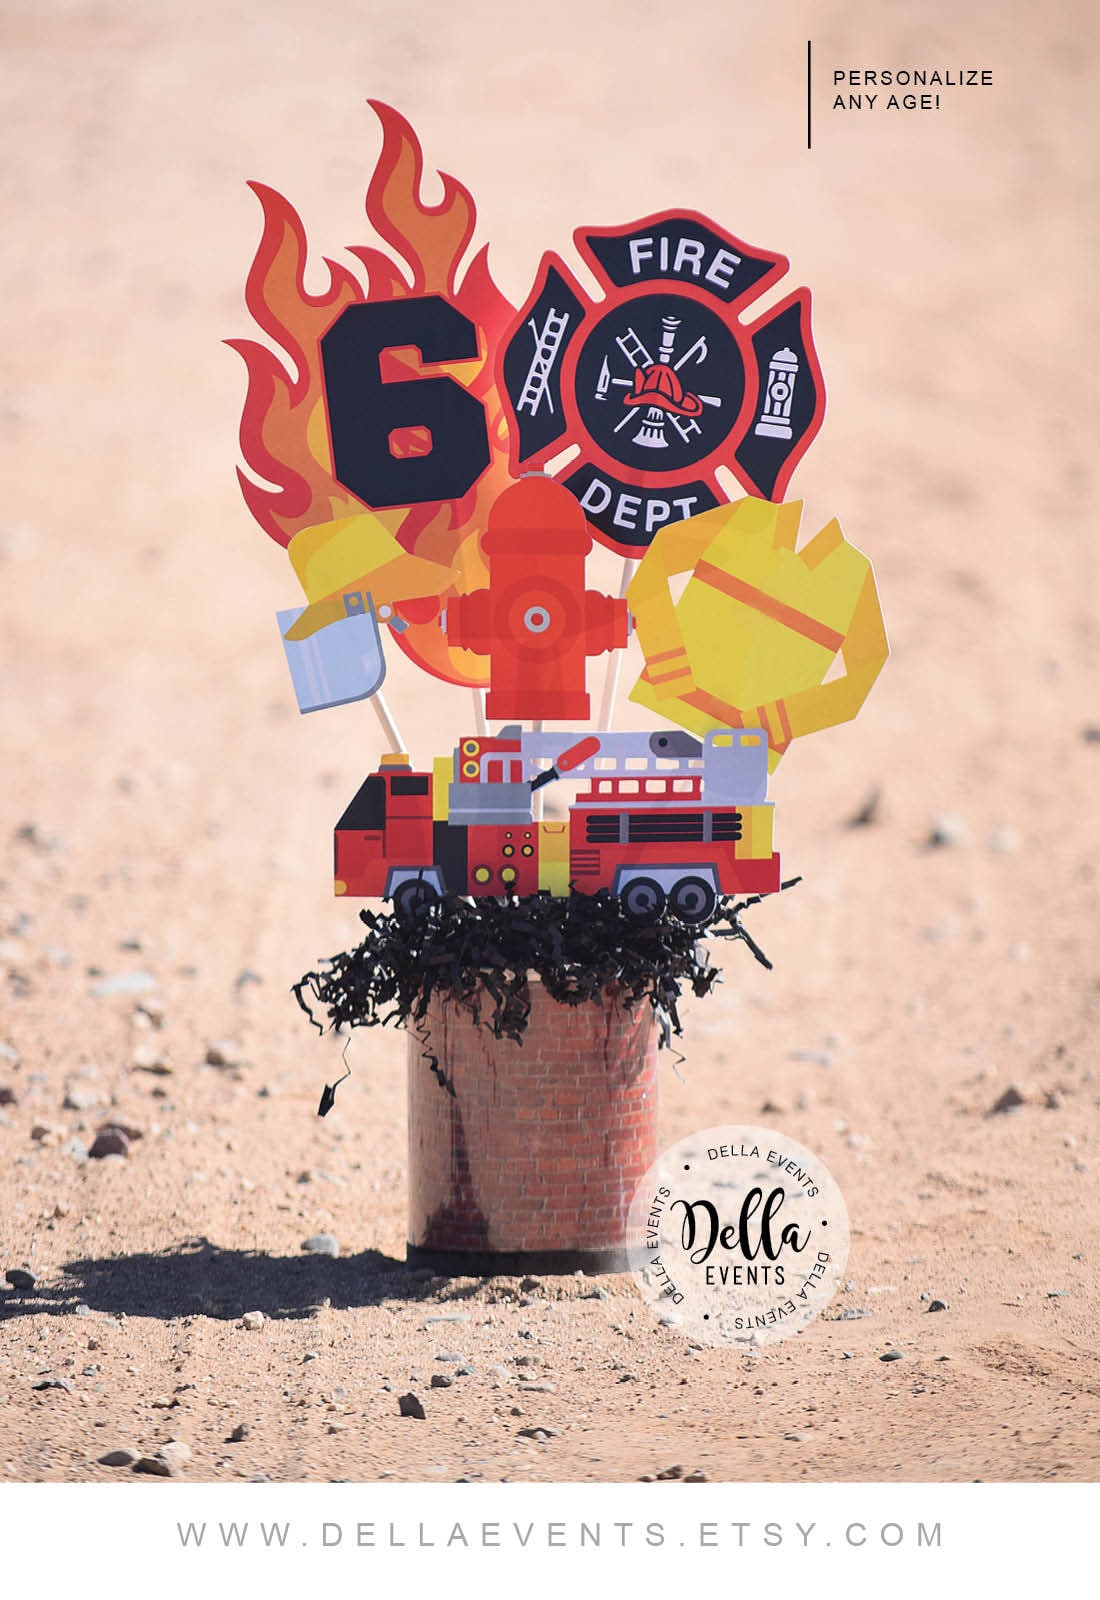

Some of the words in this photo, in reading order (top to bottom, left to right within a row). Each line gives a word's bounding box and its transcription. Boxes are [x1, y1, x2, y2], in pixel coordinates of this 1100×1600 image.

[629, 236, 741, 289] FIRE
[320, 294, 492, 509] 6
[580, 478, 698, 532] DEPT
